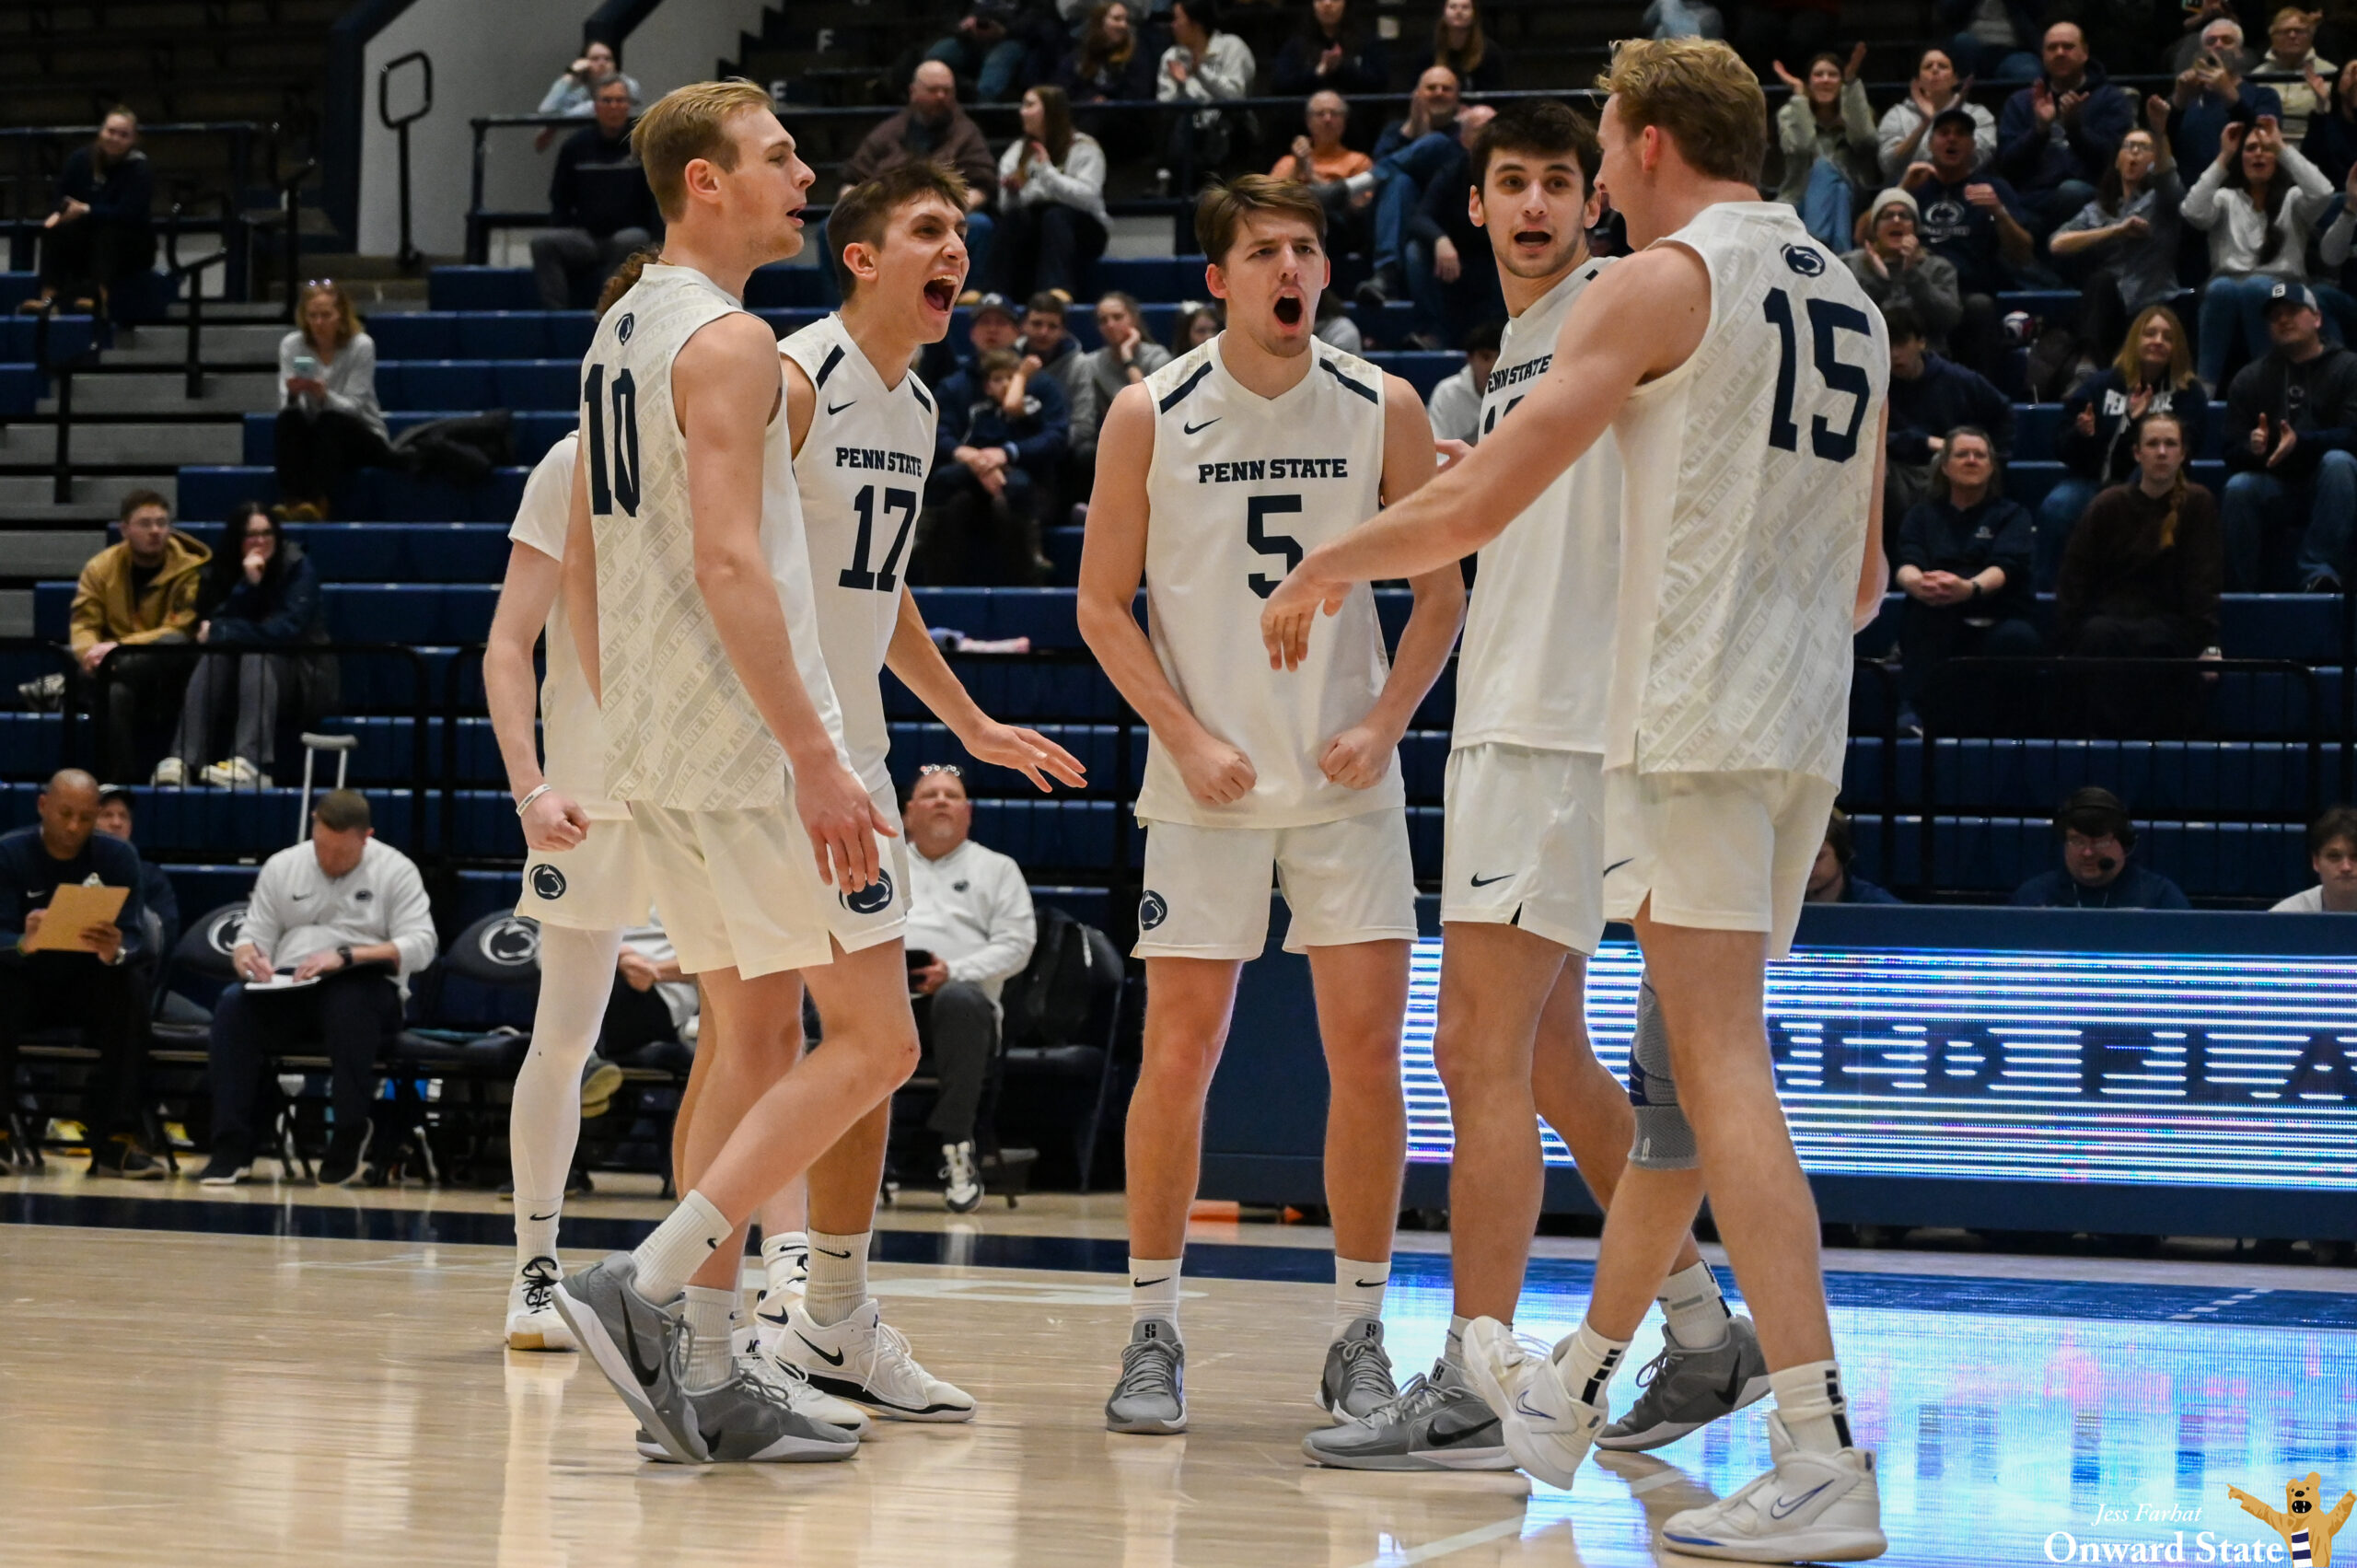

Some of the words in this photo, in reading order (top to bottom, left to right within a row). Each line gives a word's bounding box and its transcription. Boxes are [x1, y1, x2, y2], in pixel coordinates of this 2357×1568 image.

[817, 29, 834, 53] F
[1486, 367, 1510, 394] ENN
[1507, 354, 1553, 385] STATE
[1762, 287, 1872, 463] 15
[584, 364, 641, 517] 10
[836, 447, 886, 470] PENN
[887, 451, 923, 478] STATE
[1198, 459, 1266, 483] PENN
[1270, 459, 1348, 480] STATE
[838, 484, 917, 593] 17
[1247, 494, 1304, 599] 5
